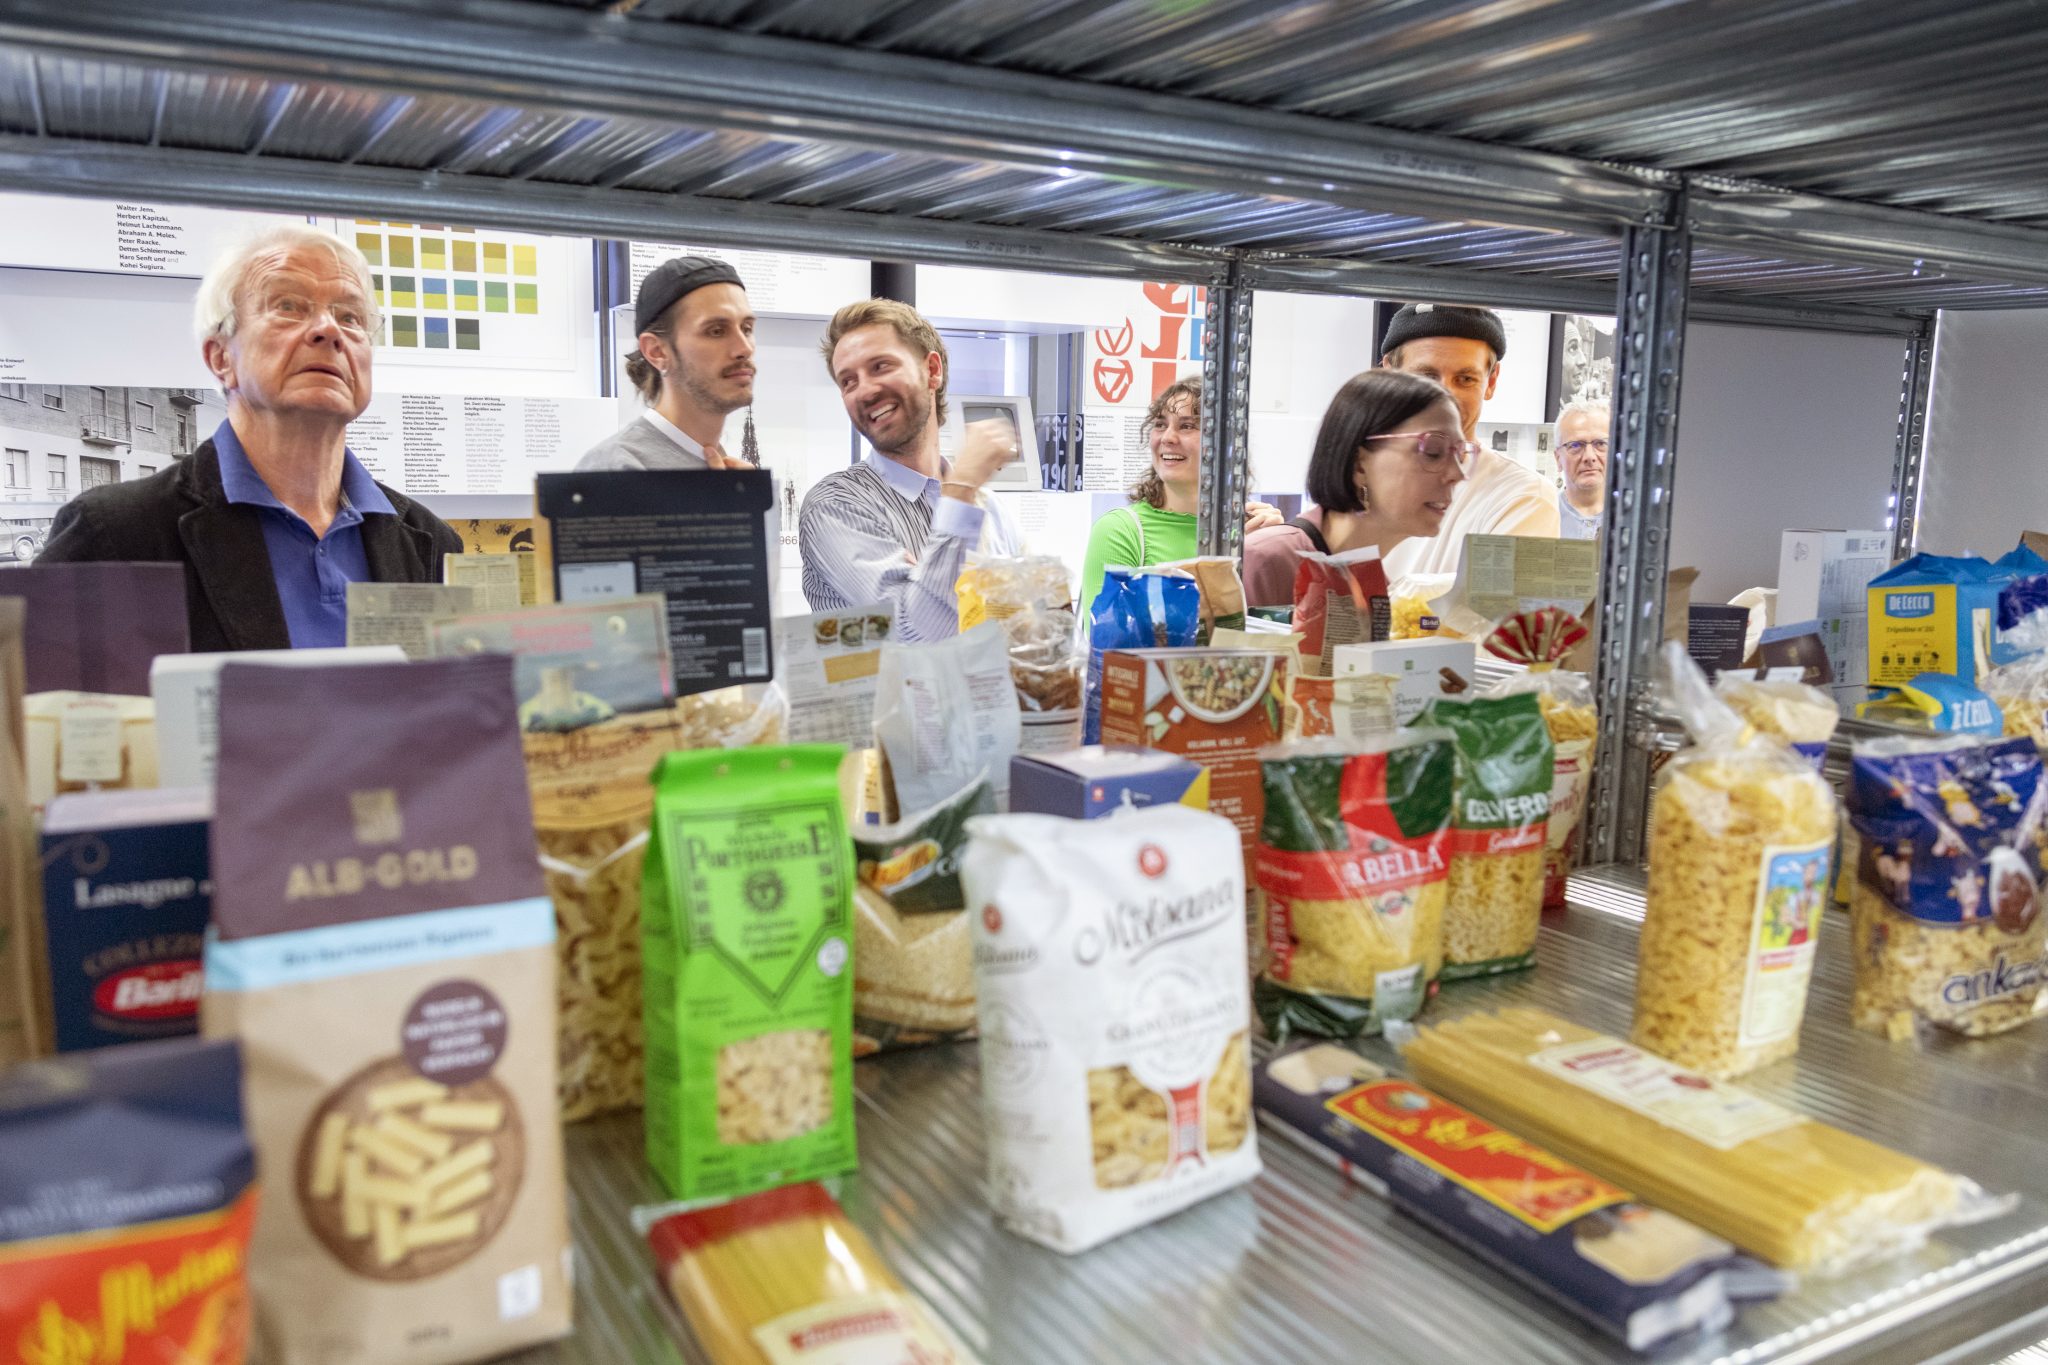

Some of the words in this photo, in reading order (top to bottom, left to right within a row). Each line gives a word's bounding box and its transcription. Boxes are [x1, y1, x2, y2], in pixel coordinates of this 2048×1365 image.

[142, 223, 183, 231] Lachenmann,
[140, 247, 187, 255] Schleiermacher,
[780, 536, 797, 545] 966
[286, 846, 478, 899] ALB-GOLD
[75, 877, 196, 910] Lasagne
